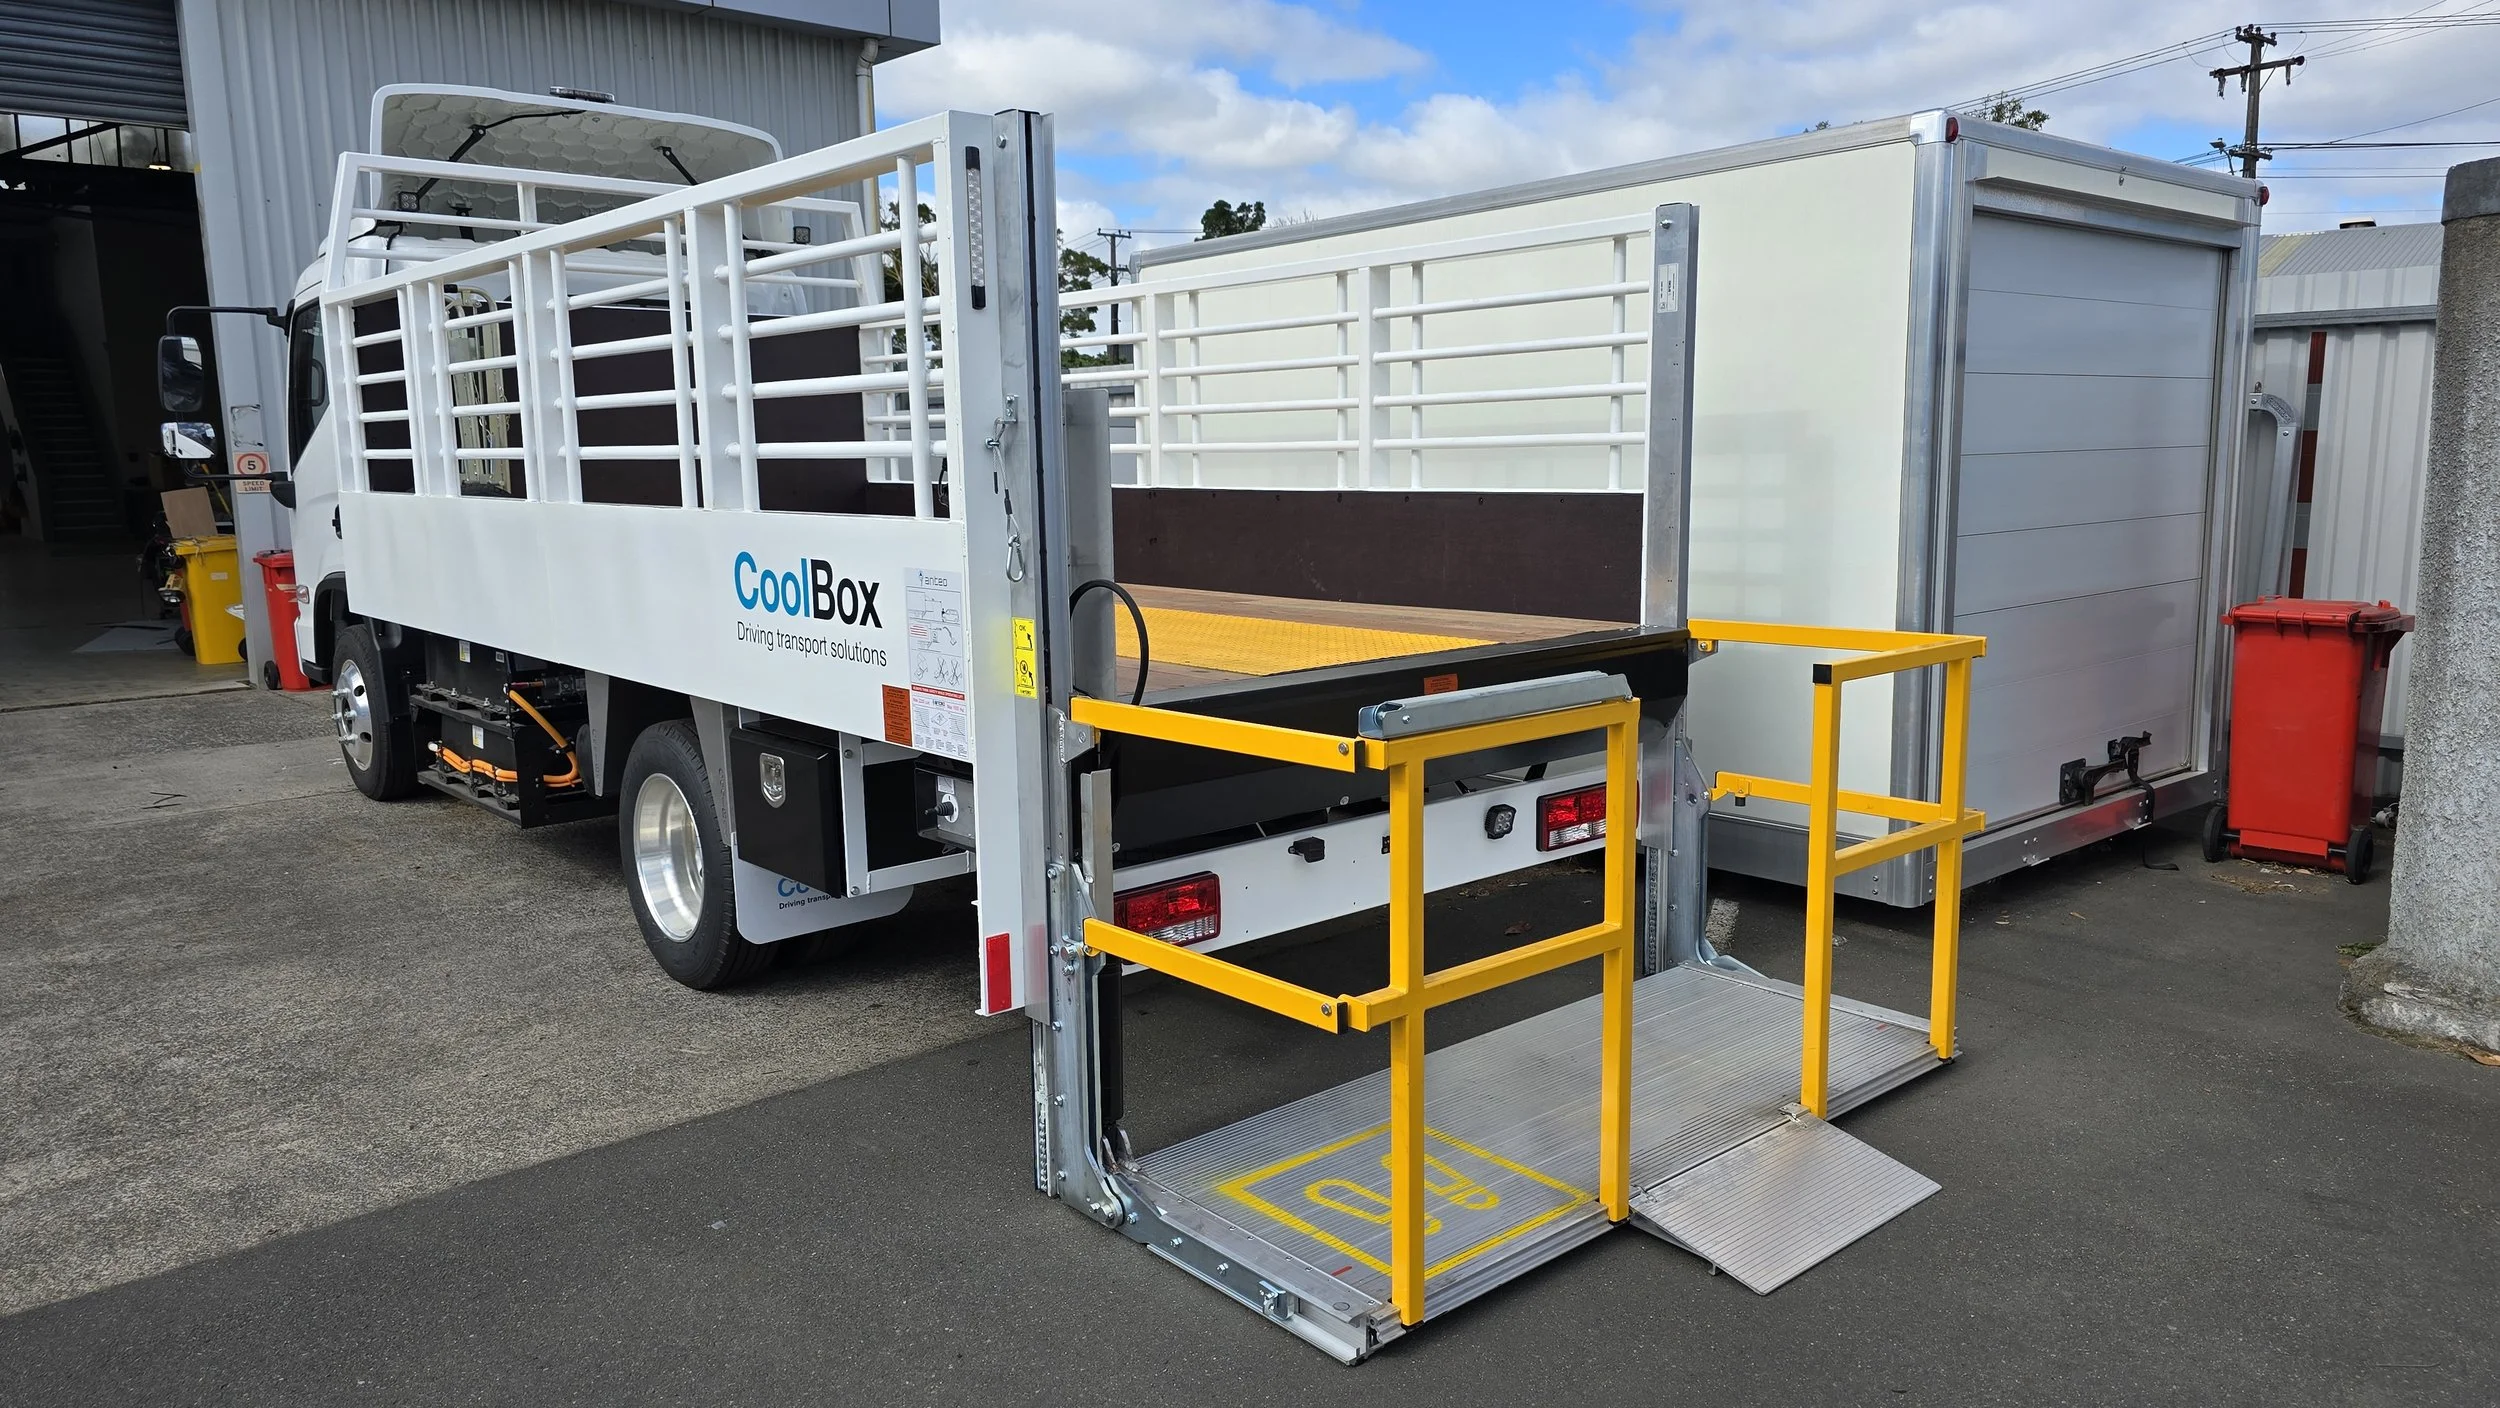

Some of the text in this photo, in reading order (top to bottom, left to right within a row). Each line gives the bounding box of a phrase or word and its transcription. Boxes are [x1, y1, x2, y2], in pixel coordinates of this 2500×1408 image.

[247, 460, 256, 471] 5
[734, 551, 883, 629] CoolBox
[737, 621, 887, 667] Driving transport solutions
[779, 899, 806, 910] Driving
